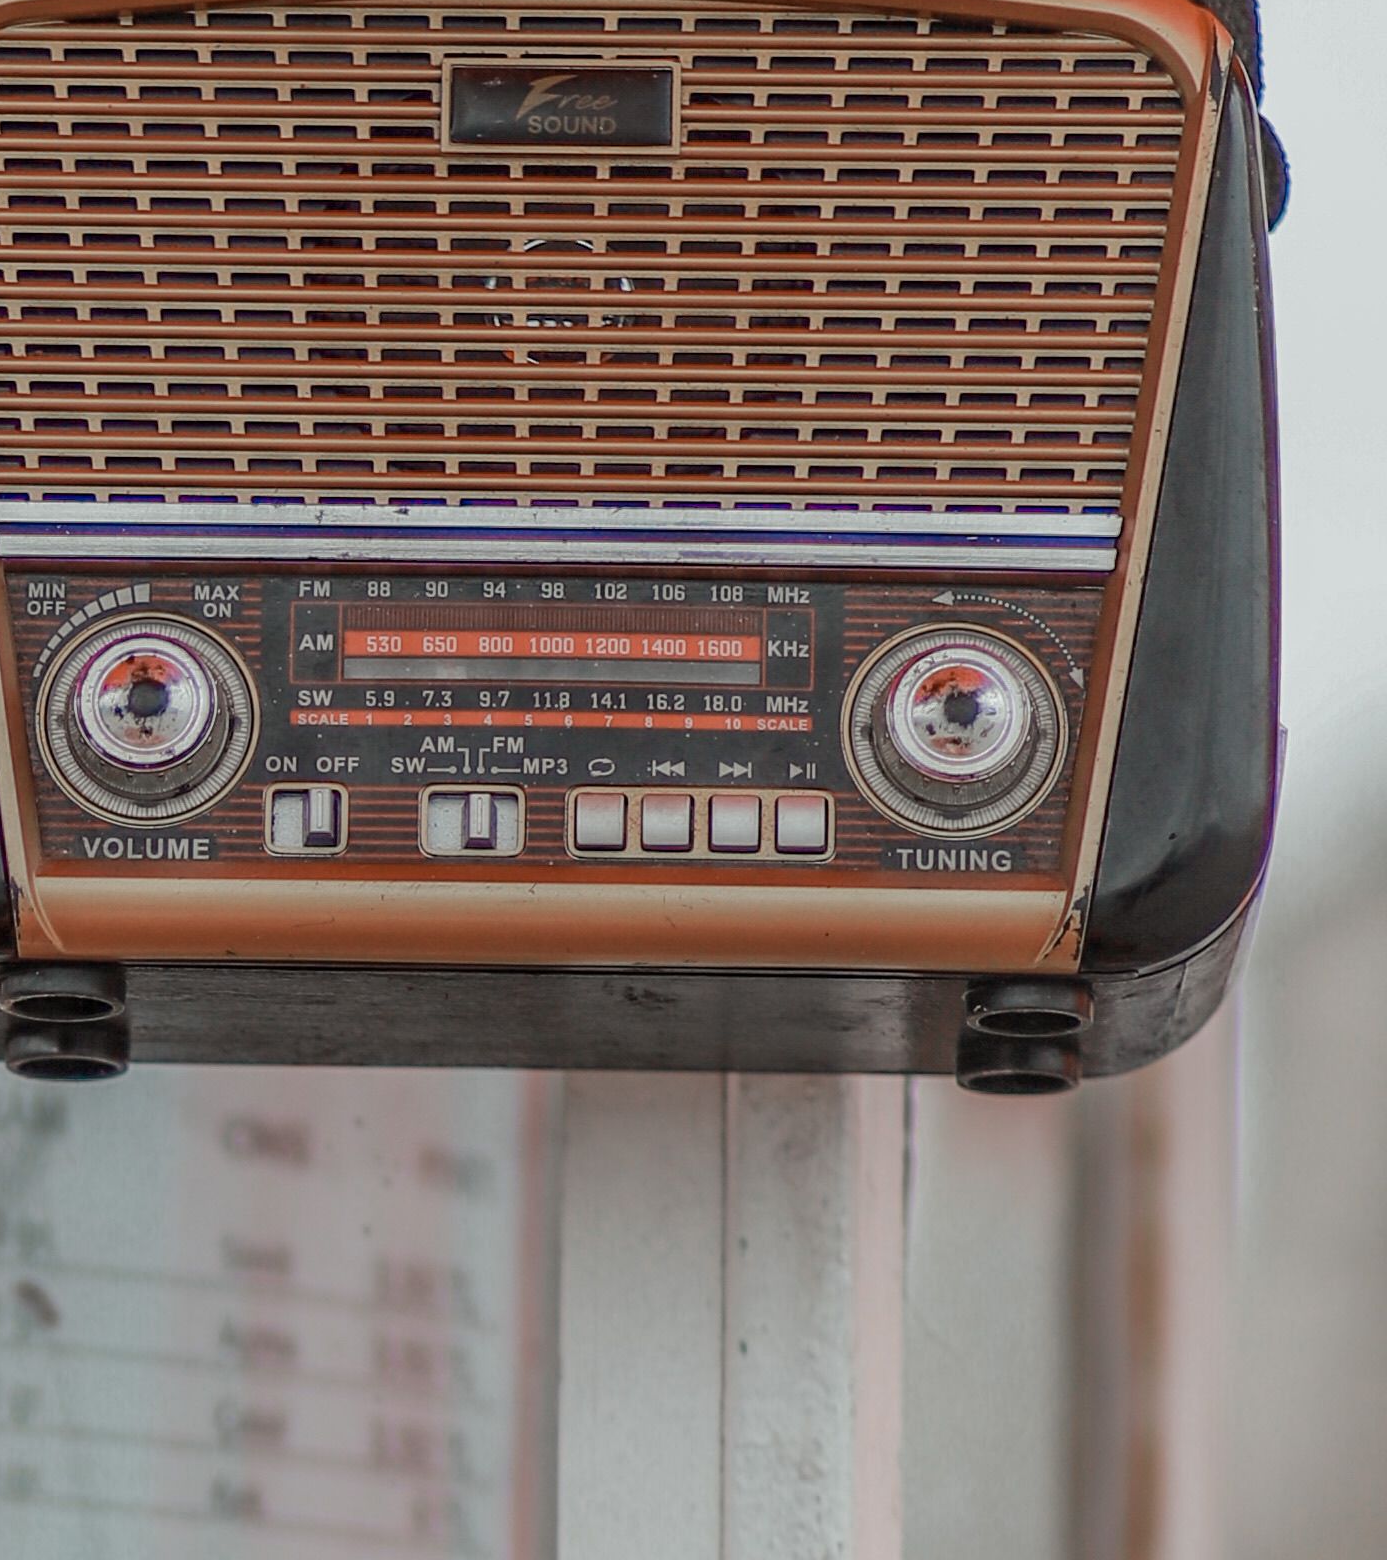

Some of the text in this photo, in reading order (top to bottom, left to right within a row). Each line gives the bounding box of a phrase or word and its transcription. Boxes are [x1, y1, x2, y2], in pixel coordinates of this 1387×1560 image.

[515, 74, 618, 122] Free
[528, 115, 616, 135] SOUND
[28, 583, 66, 598] MIN
[194, 585, 240, 601] MAX
[298, 580, 810, 603] FM 88 90 94 98 102 106 108 MHz
[27, 601, 66, 616] OFF
[203, 603, 232, 618] ON
[298, 634, 810, 657] AM 530 650 800 1000 1200 1400 1600 KHz
[297, 690, 809, 713] SW 5.9 7.3 9.7 11.8 14.1 16.2 18.0 MHz
[297, 713, 808, 731] SCALE 1 2 3 4 5 6 7 8 9 10 SCALE
[420, 737, 454, 753] AM
[493, 737, 524, 753] FM
[265, 756, 297, 773] ON
[316, 756, 360, 773] OFF
[391, 757, 426, 773] SW
[523, 758, 569, 775] MP3
[83, 837, 210, 859] VOLUME
[896, 848, 1012, 871] TUNING
